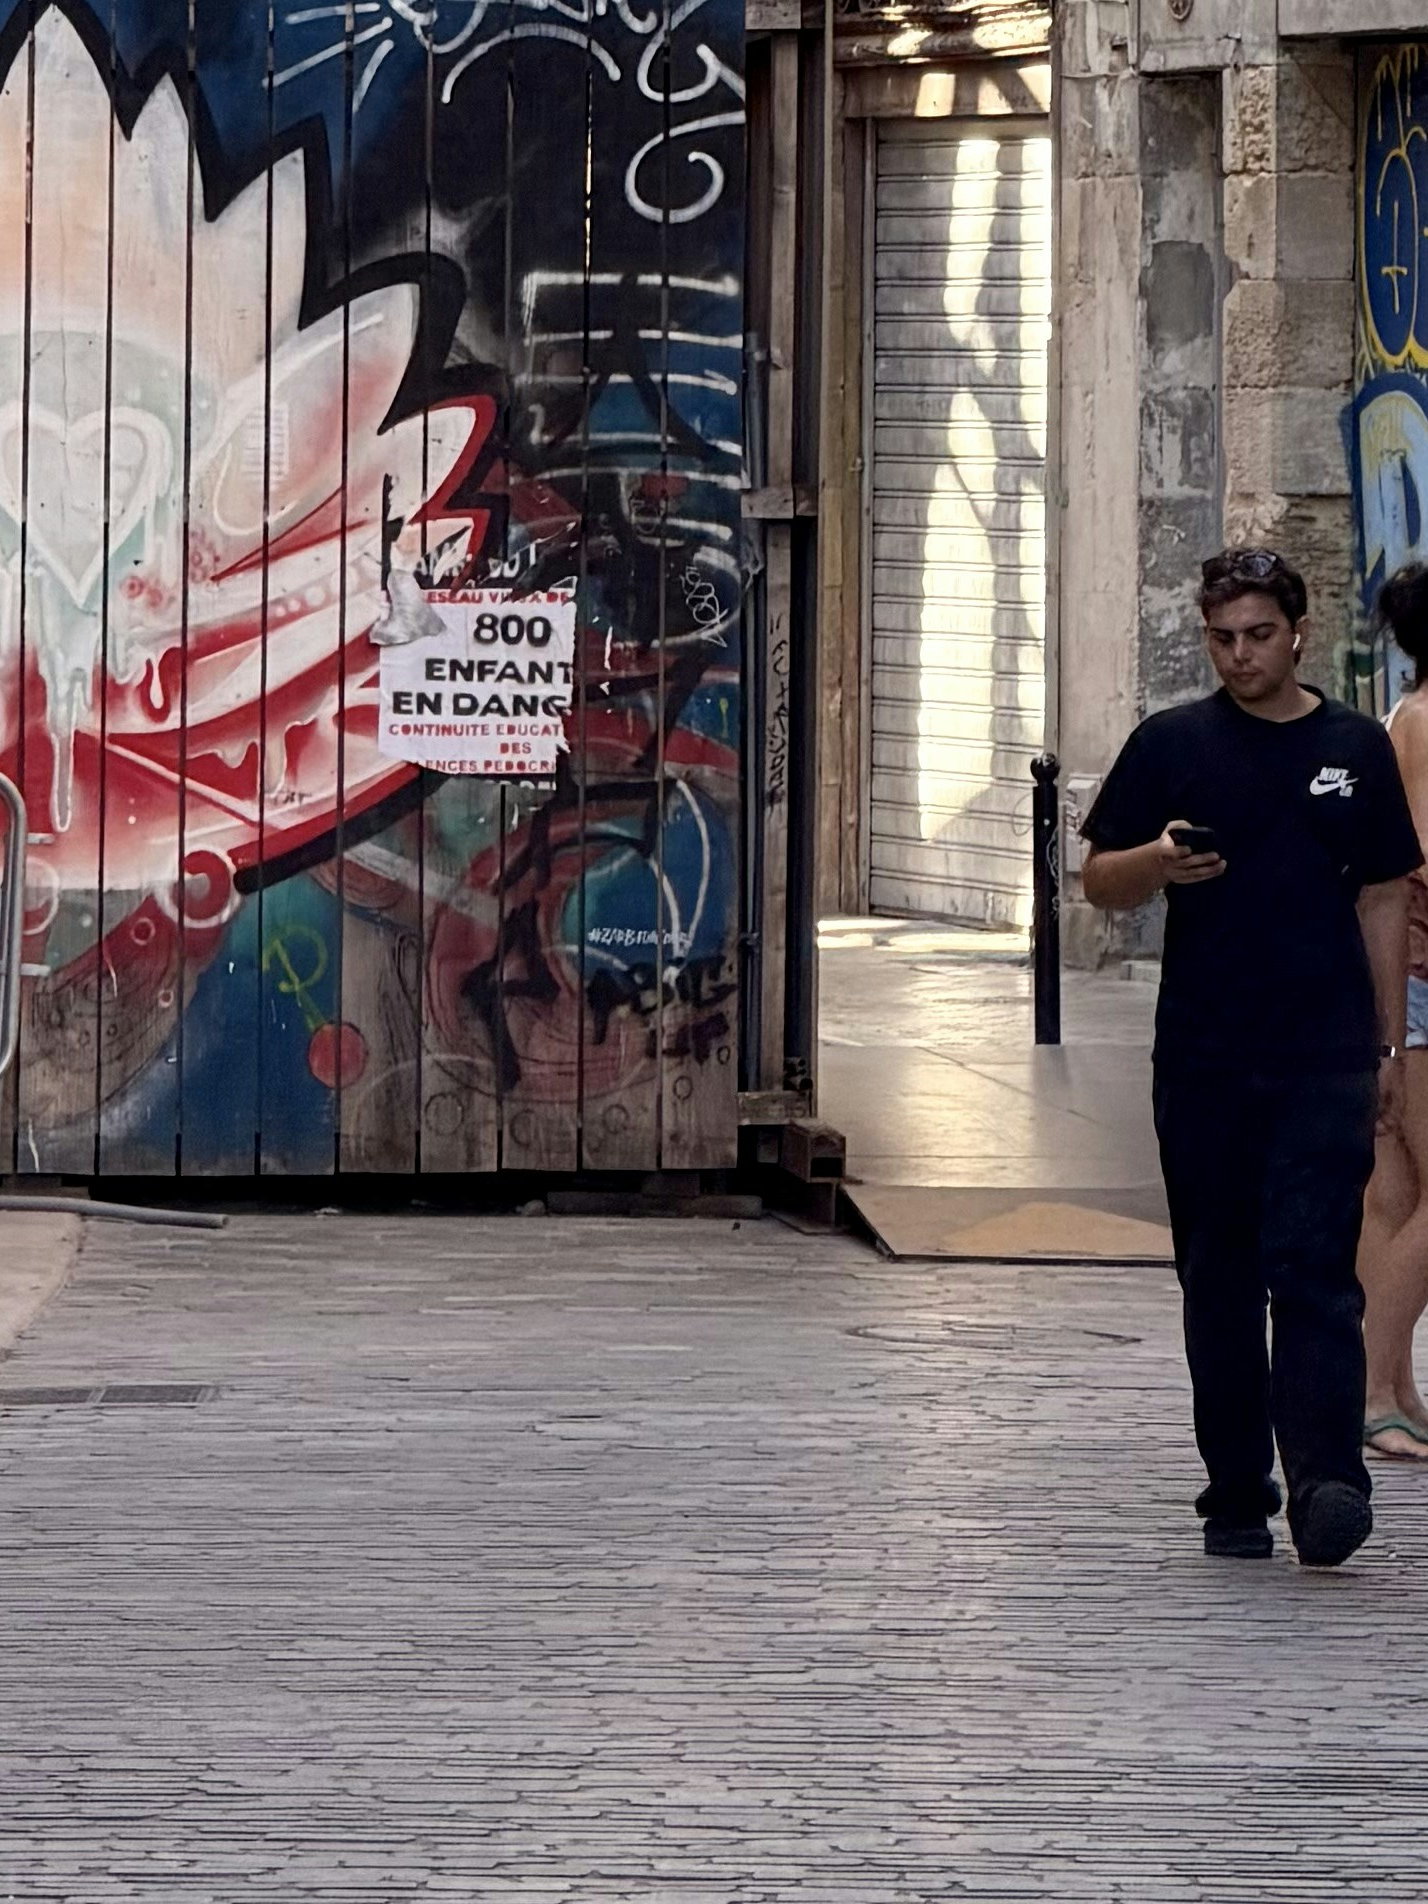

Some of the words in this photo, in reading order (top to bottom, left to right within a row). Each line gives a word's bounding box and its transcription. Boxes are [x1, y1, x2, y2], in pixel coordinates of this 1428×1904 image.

[473, 612, 552, 647] 800
[425, 657, 573, 685] ENFANT
[392, 690, 442, 716] EN
[388, 723, 490, 737] CONTINUITE
[499, 742, 532, 755] DES
